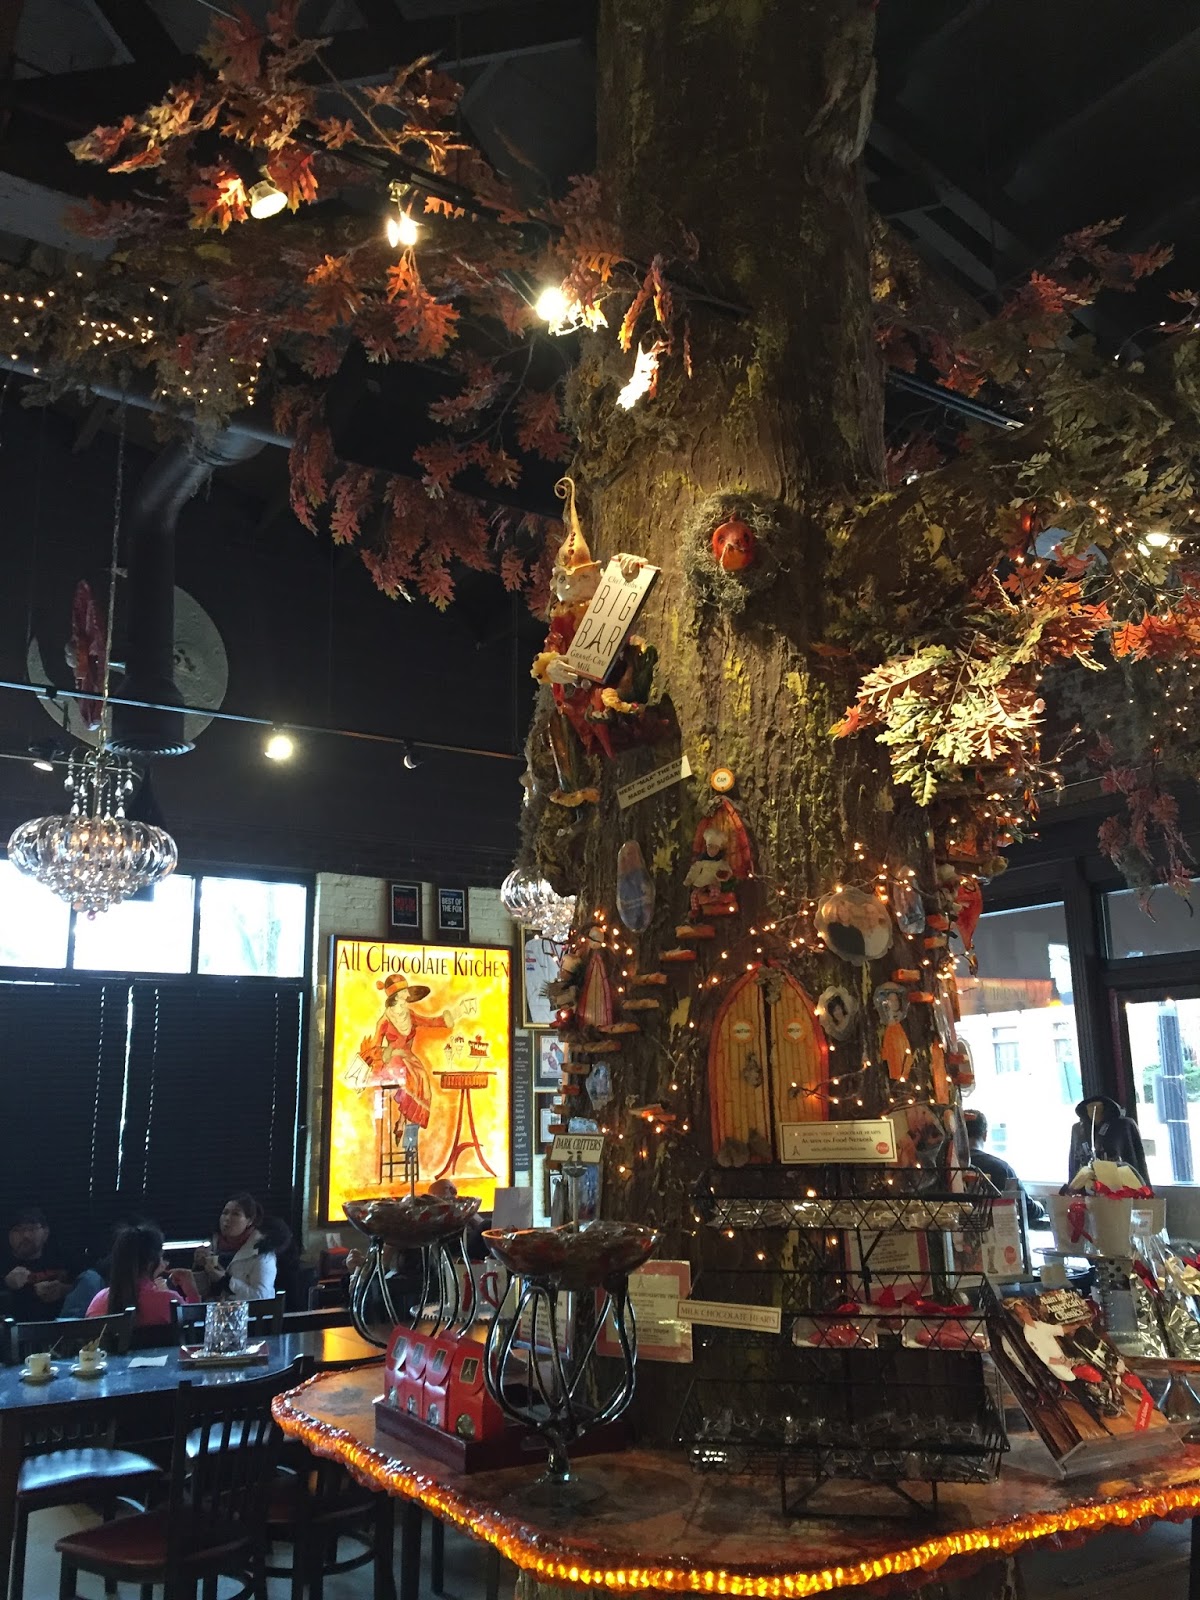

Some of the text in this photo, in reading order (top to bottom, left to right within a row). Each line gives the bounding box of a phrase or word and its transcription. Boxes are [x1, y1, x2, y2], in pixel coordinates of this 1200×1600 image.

[592, 585, 638, 621] BIG
[575, 618, 621, 657] BAR
[577, 662, 591, 673] Milk
[619, 785, 636, 796] MEET
[657, 767, 670, 776] THE
[627, 789, 646, 800] MADE
[647, 783, 655, 791] OF
[441, 897, 463, 906] BEST OF
[452, 905, 463, 913] FOX
[338, 942, 361, 971] All
[366, 944, 449, 975] Chocolate
[454, 950, 510, 978] Kitchen
[555, 1137, 602, 1151] DARK CRITTERS
[1046, 1300, 1081, 1313] American
[680, 1307, 776, 1324] MILK CHOCOLATE HEARTS
